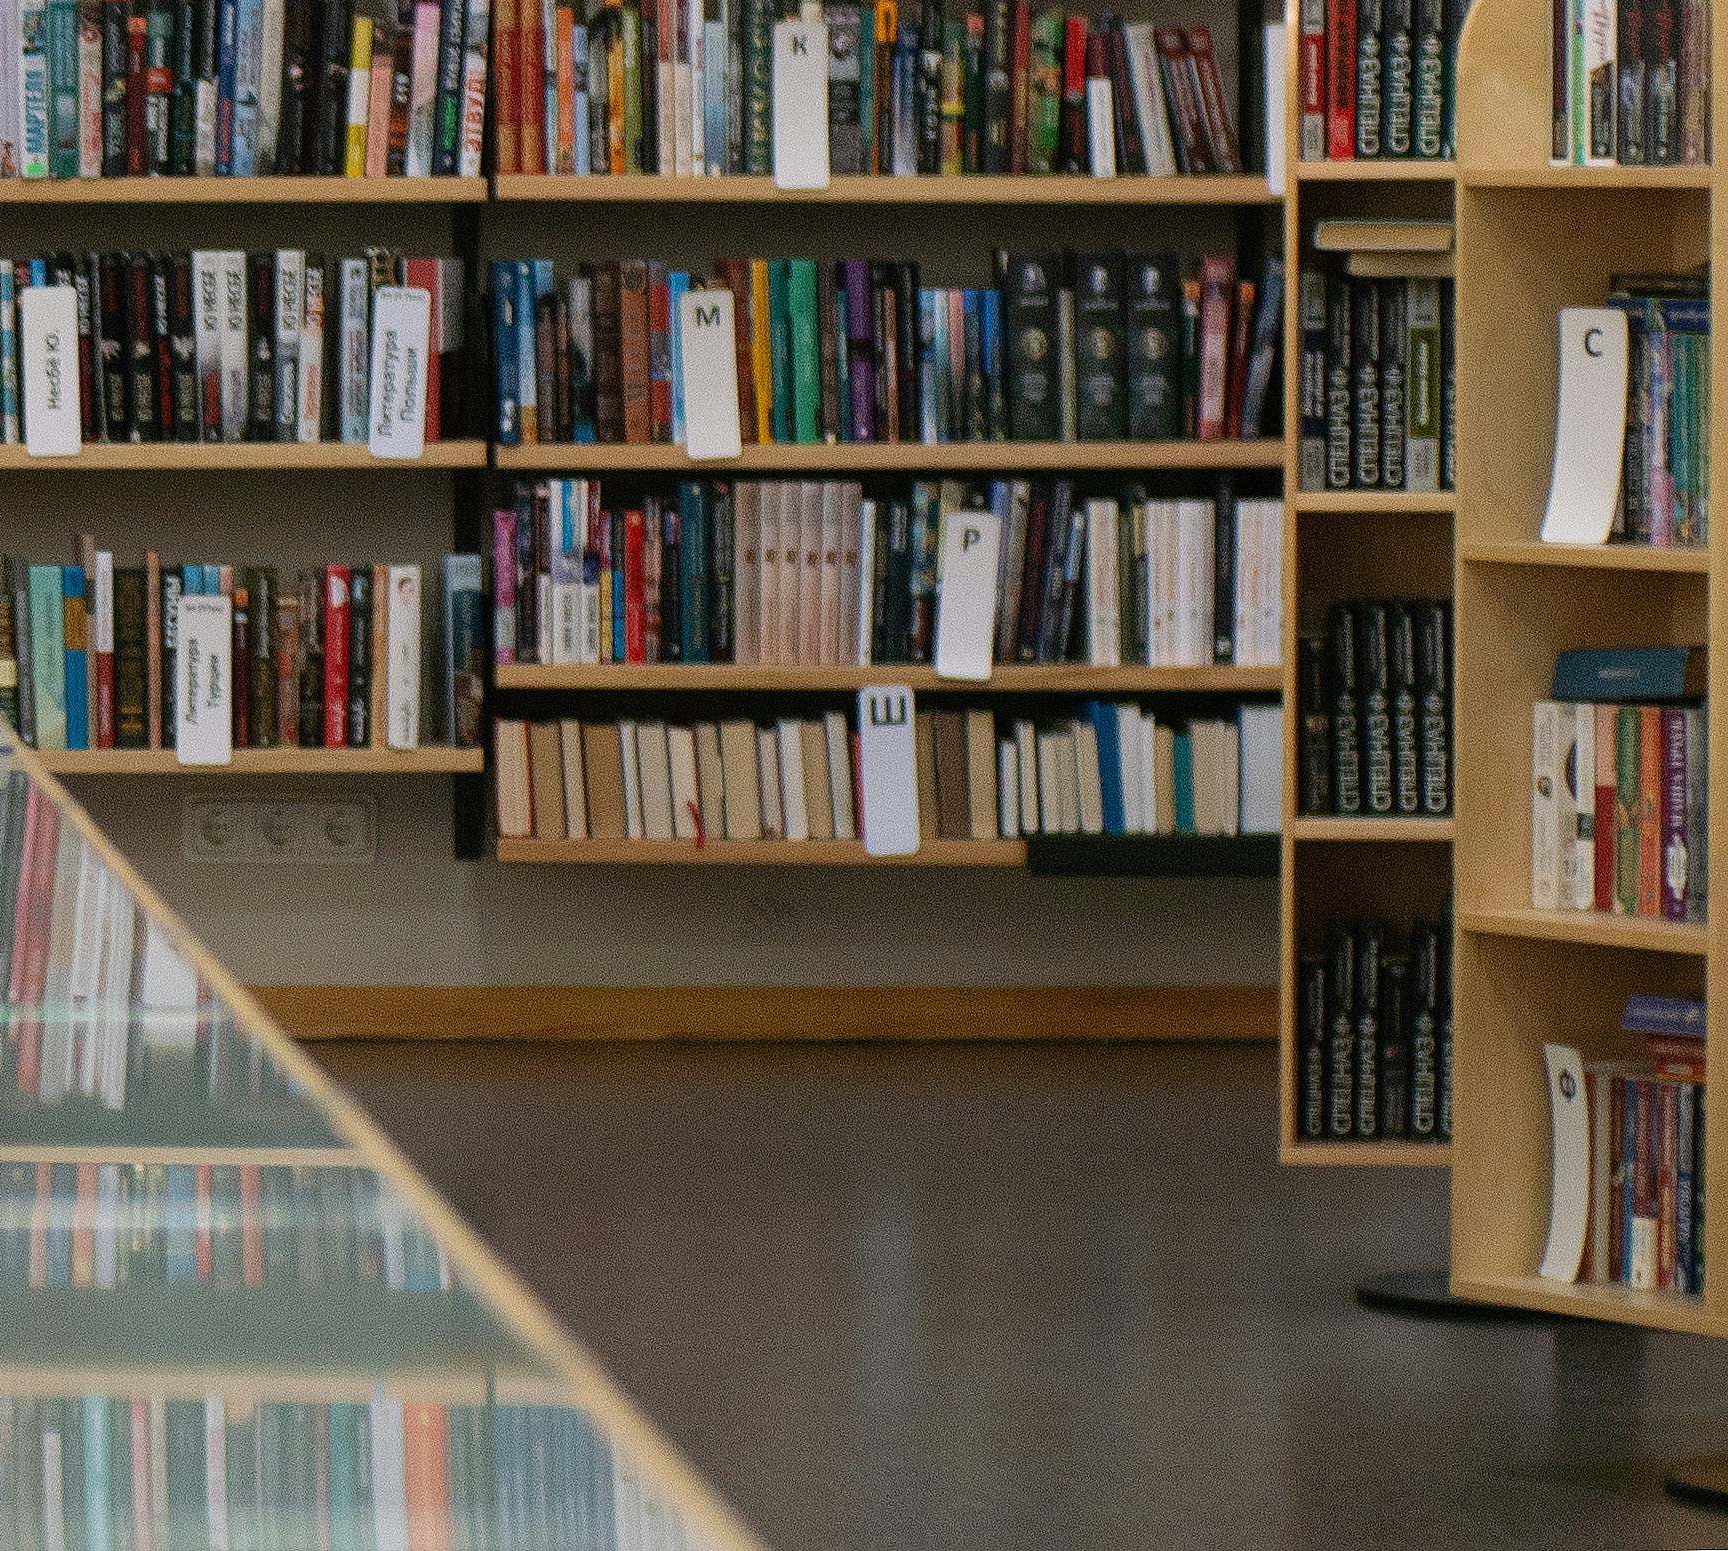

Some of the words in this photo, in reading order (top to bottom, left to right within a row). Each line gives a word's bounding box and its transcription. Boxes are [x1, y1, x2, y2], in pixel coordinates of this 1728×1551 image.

[791, 35, 807, 54] К
[1358, 55, 1381, 156] СПЕЦНАЗ
[1388, 55, 1411, 155] СПЕЦНАЗ
[1418, 55, 1441, 156] СПЕЦНАЗ
[694, 305, 721, 326] М
[1582, 327, 1602, 358] С
[45, 357, 60, 410] Несбё
[373, 327, 399, 437] Литература
[398, 346, 418, 422] Польши
[1357, 384, 1379, 484] СПЕЦНАЗ
[1384, 386, 1403, 485] СПЕЦНАЗ
[962, 528, 981, 551] Р
[184, 637, 200, 723] Литература
[206, 653, 221, 708] Турции
[869, 696, 907, 727] Ш
[1338, 711, 1359, 811] СПЕЦНАЗ
